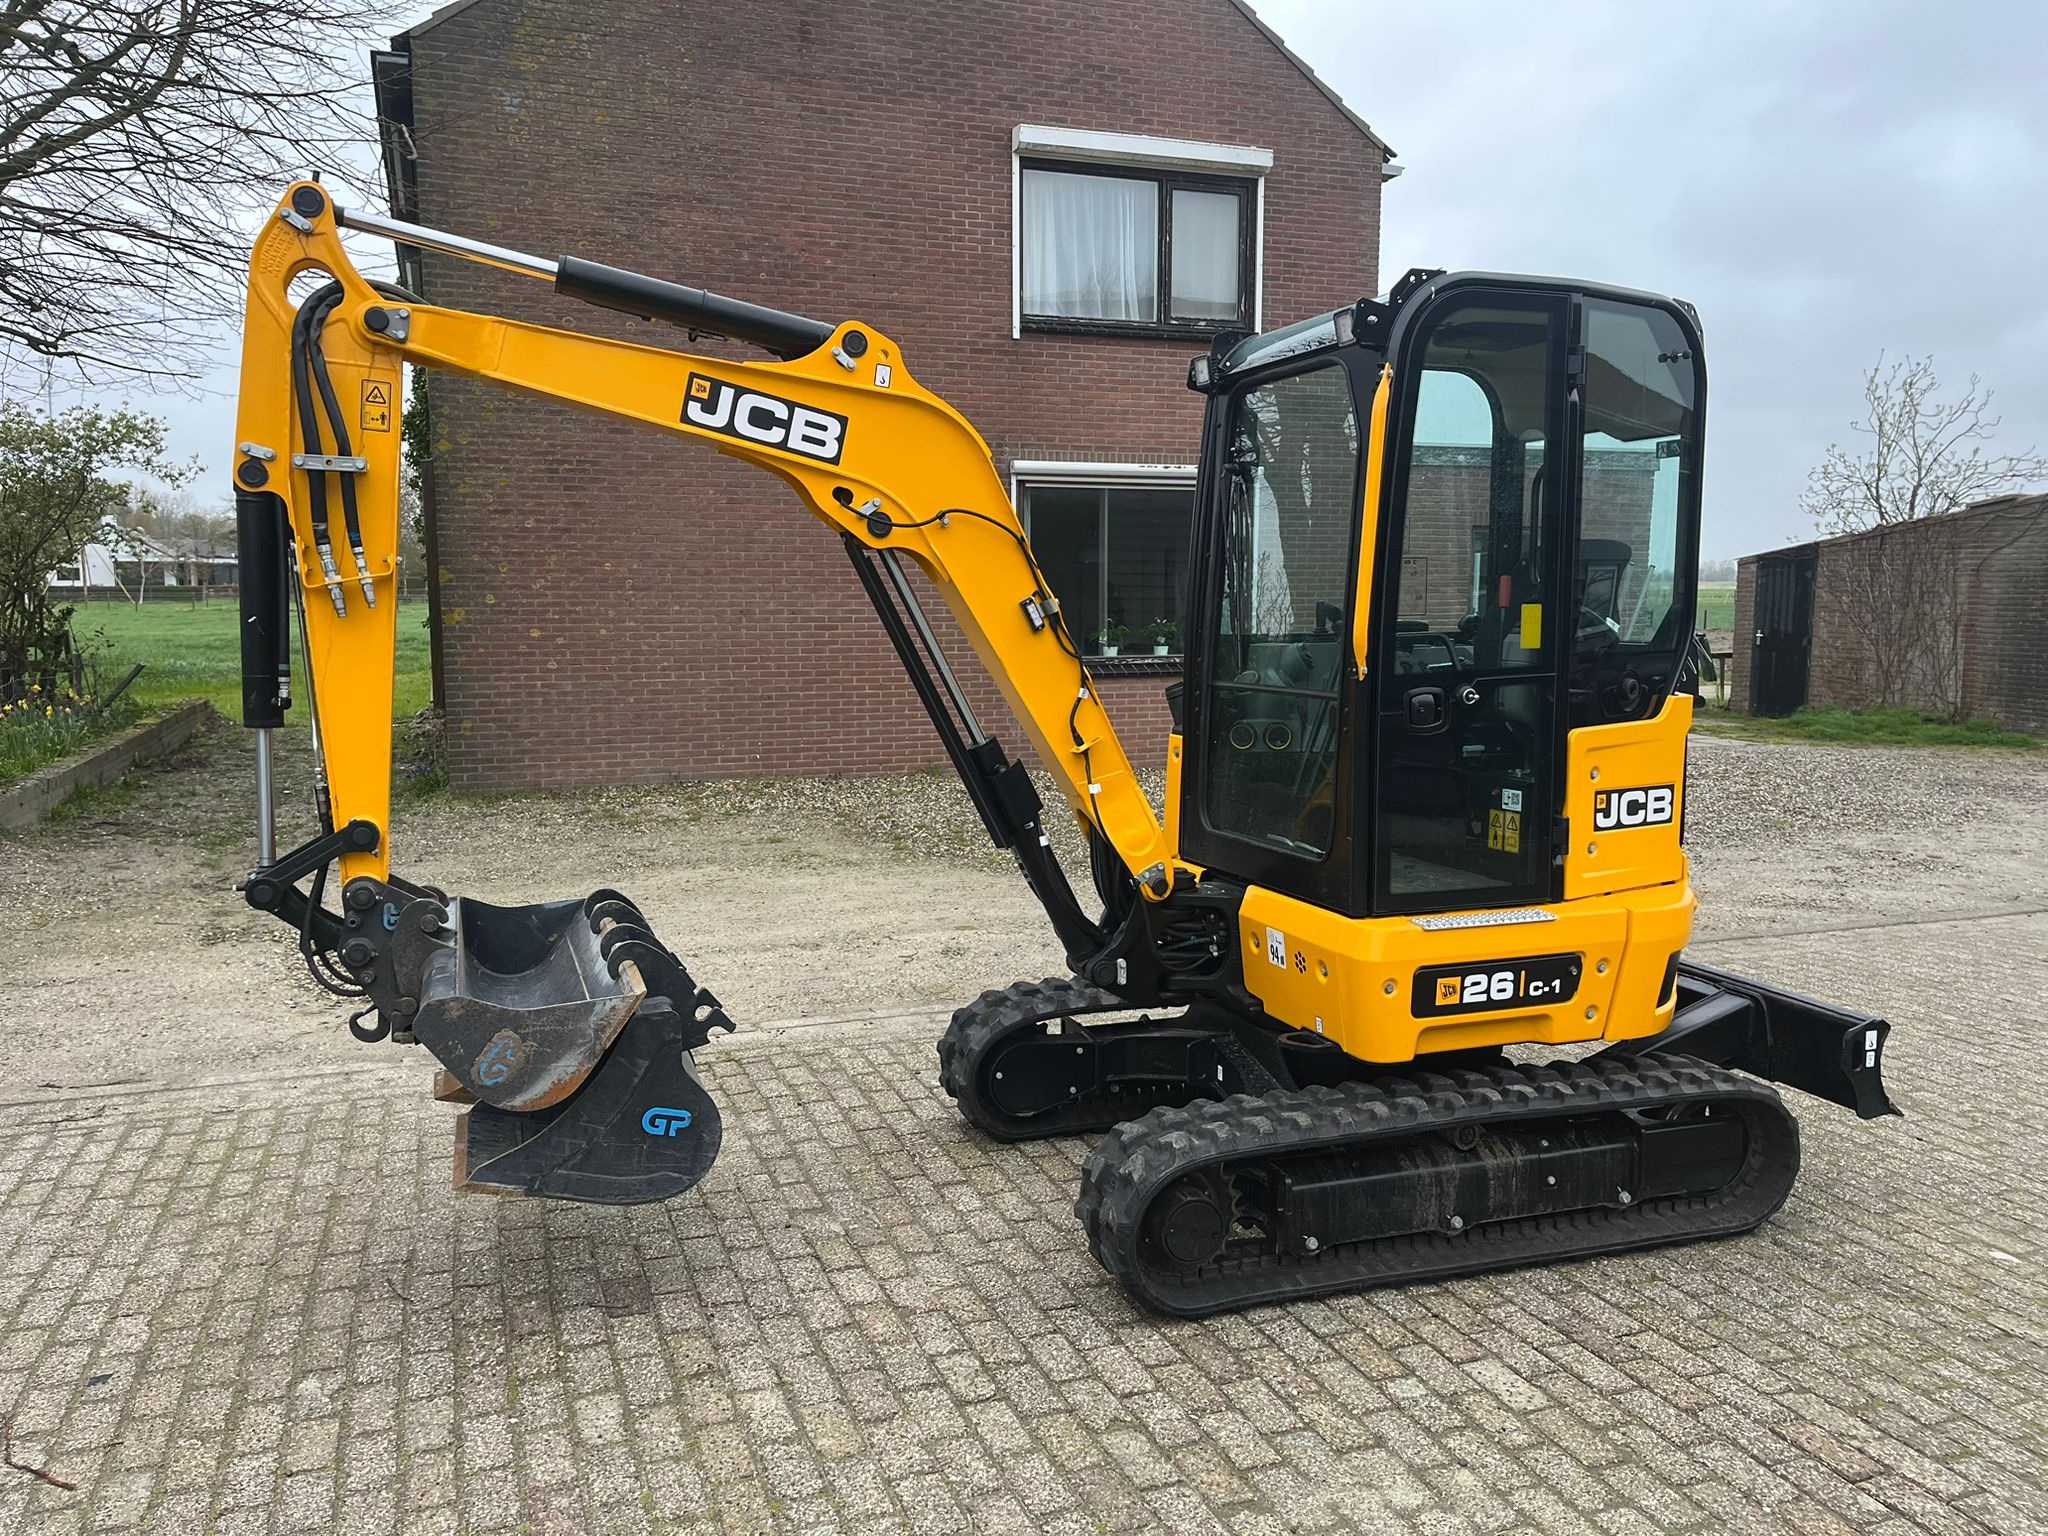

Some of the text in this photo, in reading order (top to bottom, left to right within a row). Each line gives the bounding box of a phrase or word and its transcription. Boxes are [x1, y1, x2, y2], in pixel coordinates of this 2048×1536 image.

[687, 385, 841, 459] JCB
[1596, 788, 1672, 828] JCB
[1462, 971, 1561, 1004] 26 C-1
[642, 1107, 692, 1137] GP
